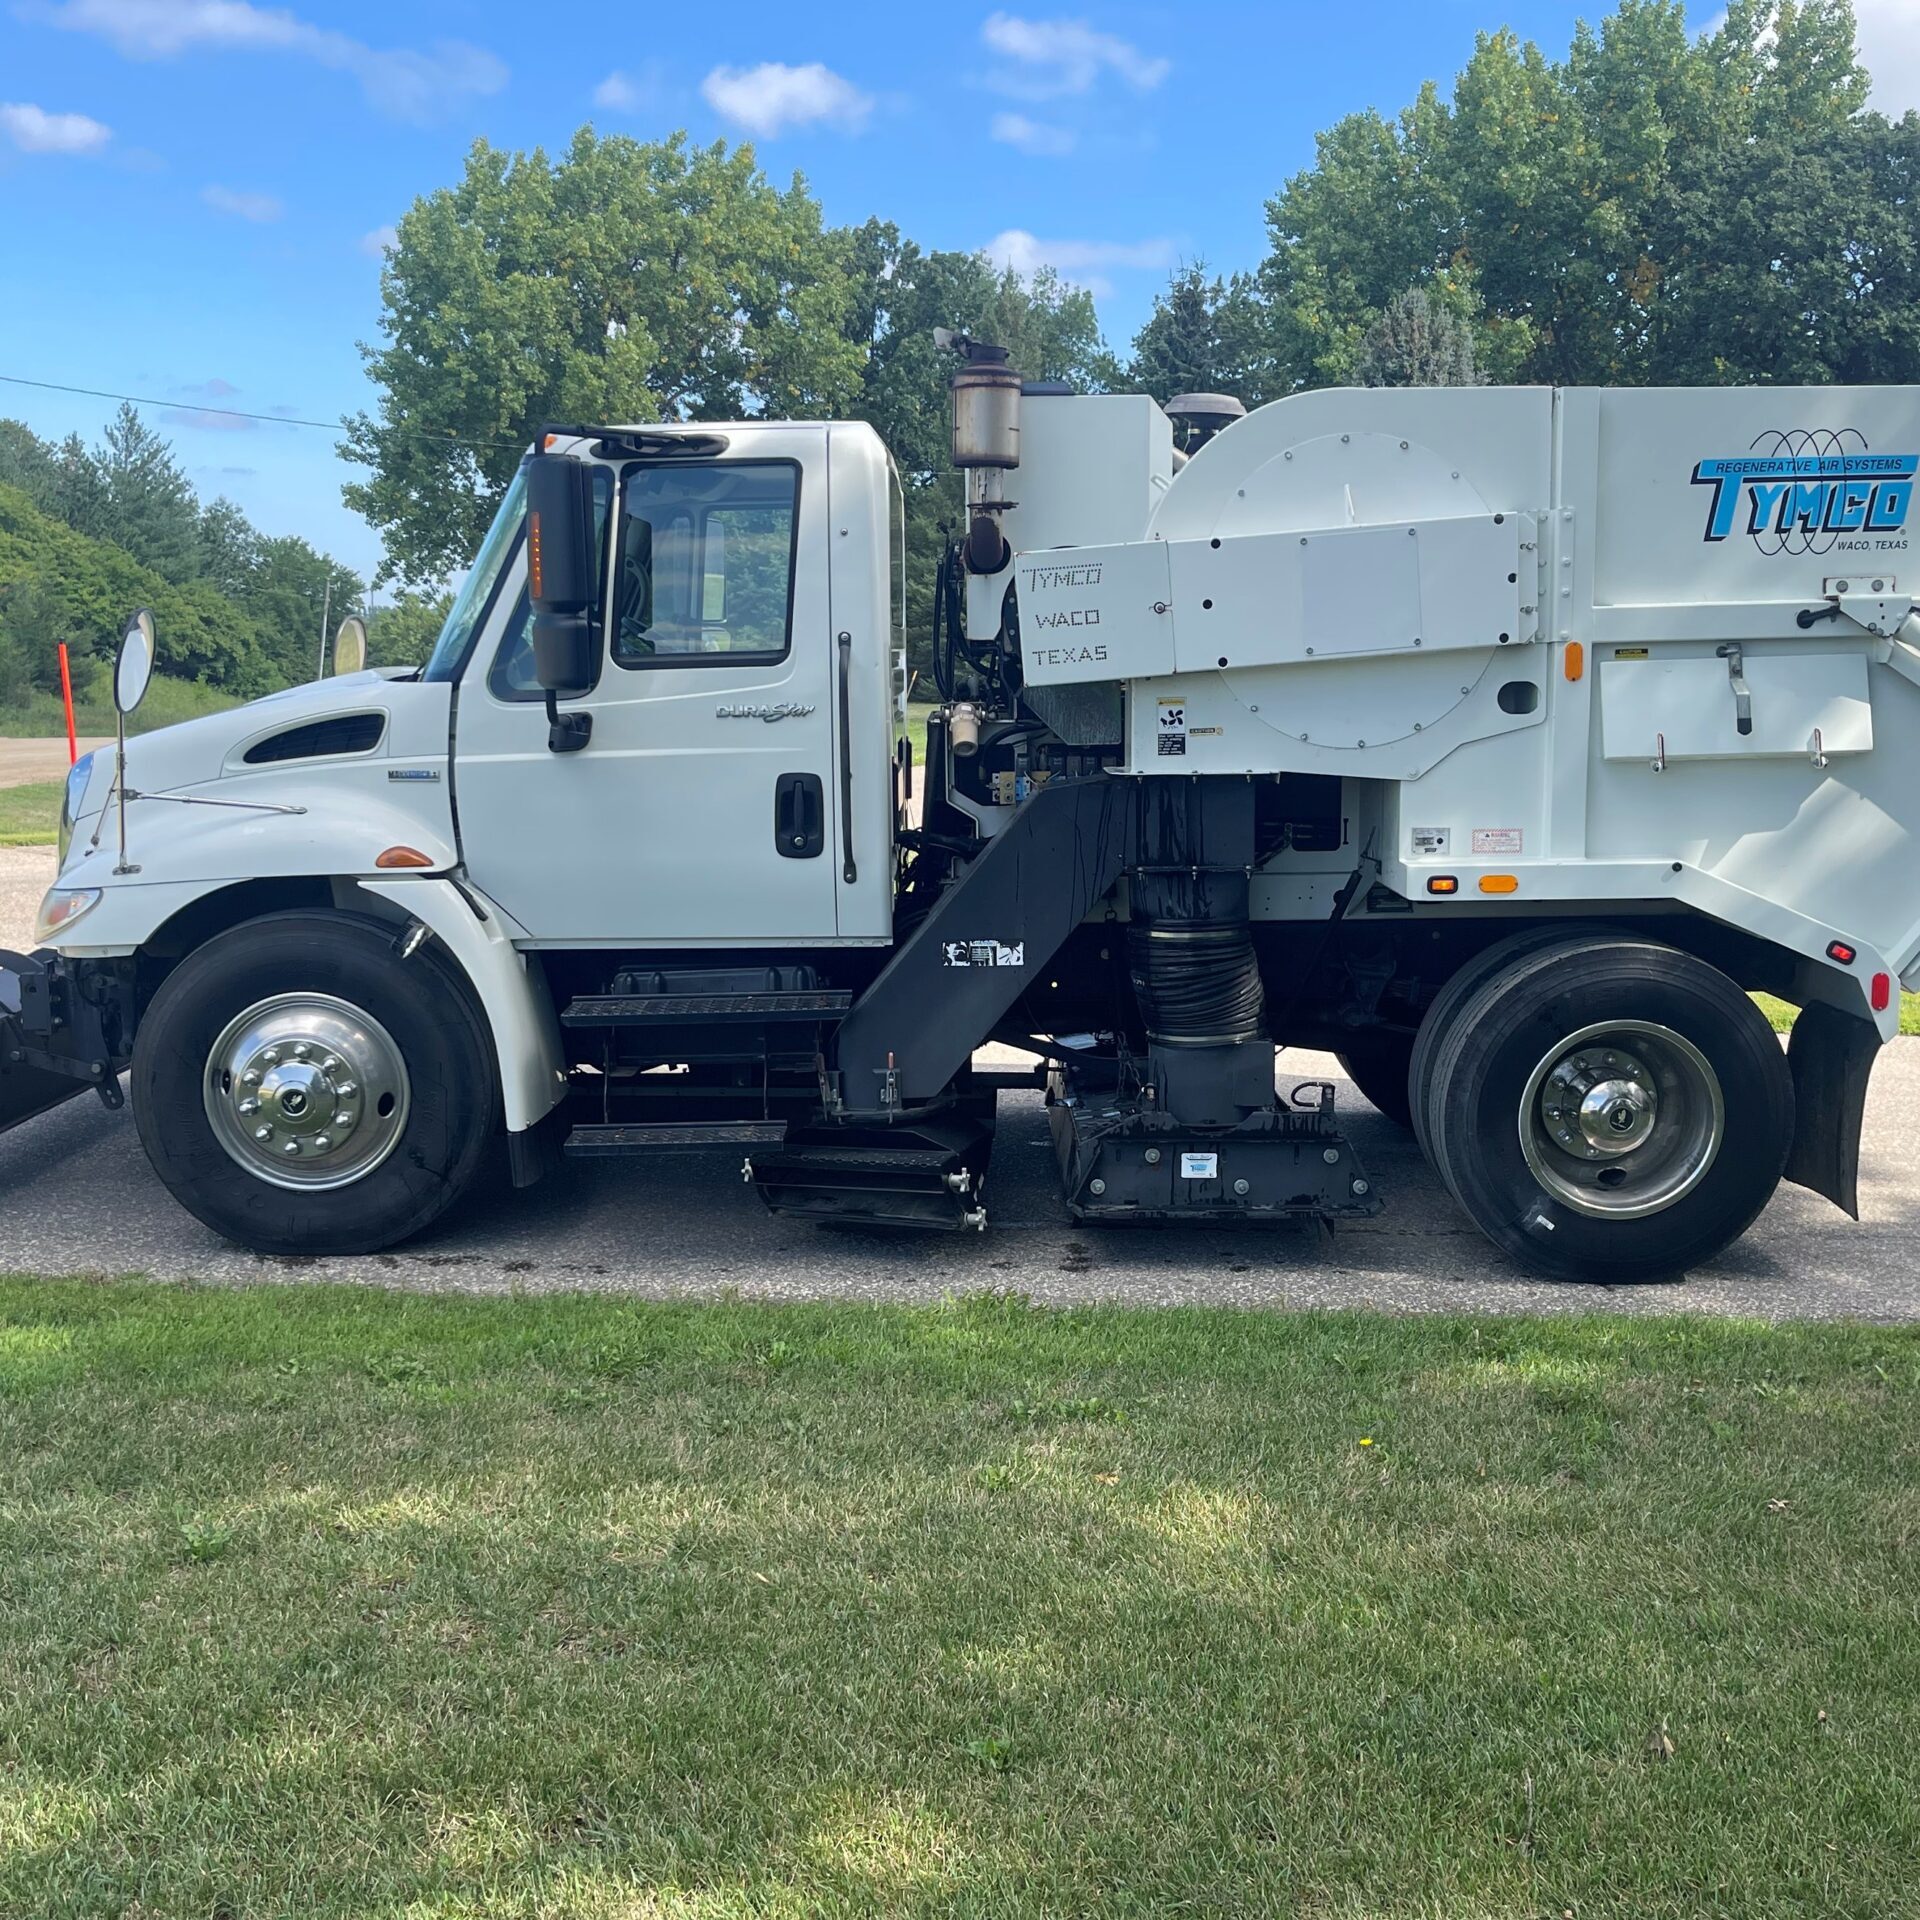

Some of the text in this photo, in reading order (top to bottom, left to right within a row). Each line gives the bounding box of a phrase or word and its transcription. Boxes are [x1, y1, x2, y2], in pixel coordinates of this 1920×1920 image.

[1716, 458, 1903, 473] REGENERATIVE AIR SYSTEMS
[1690, 454, 1919, 542] TYMCO
[1837, 540, 1909, 551] WACO, TEXAS
[1022, 563, 1102, 592] TYMCO
[1035, 609, 1100, 629] WACO
[1032, 645, 1107, 666] TEXAS
